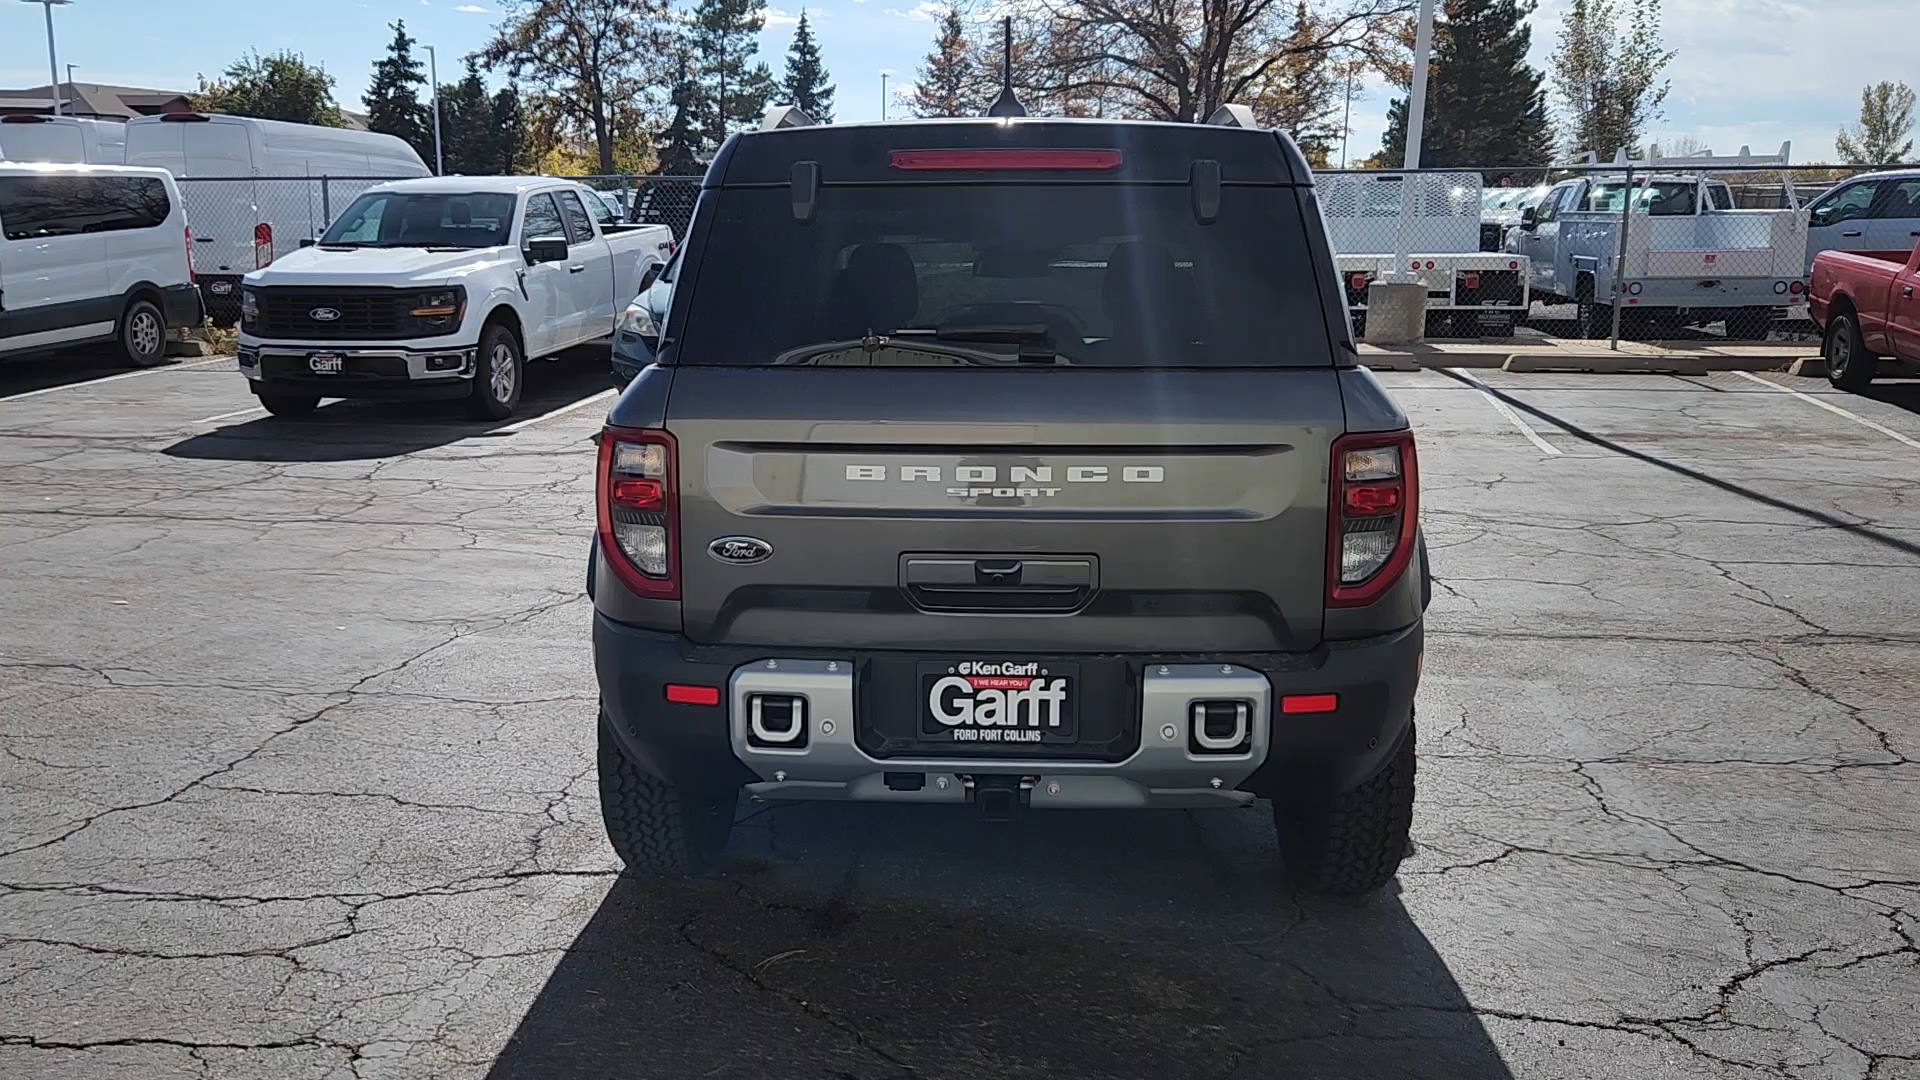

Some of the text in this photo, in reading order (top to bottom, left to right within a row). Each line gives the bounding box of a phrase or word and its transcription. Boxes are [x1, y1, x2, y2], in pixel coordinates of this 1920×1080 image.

[309, 356, 343, 370] Garff
[845, 464, 1165, 483] BRONCO
[946, 487, 1062, 498] SPORT
[722, 541, 757, 558] Ford
[972, 661, 1038, 676] Ken Garff
[978, 679, 989, 687] WE
[990, 679, 1009, 687] HEAR
[929, 675, 1067, 727] Garff
[953, 728, 1042, 742] FORD FORT COLLINS
